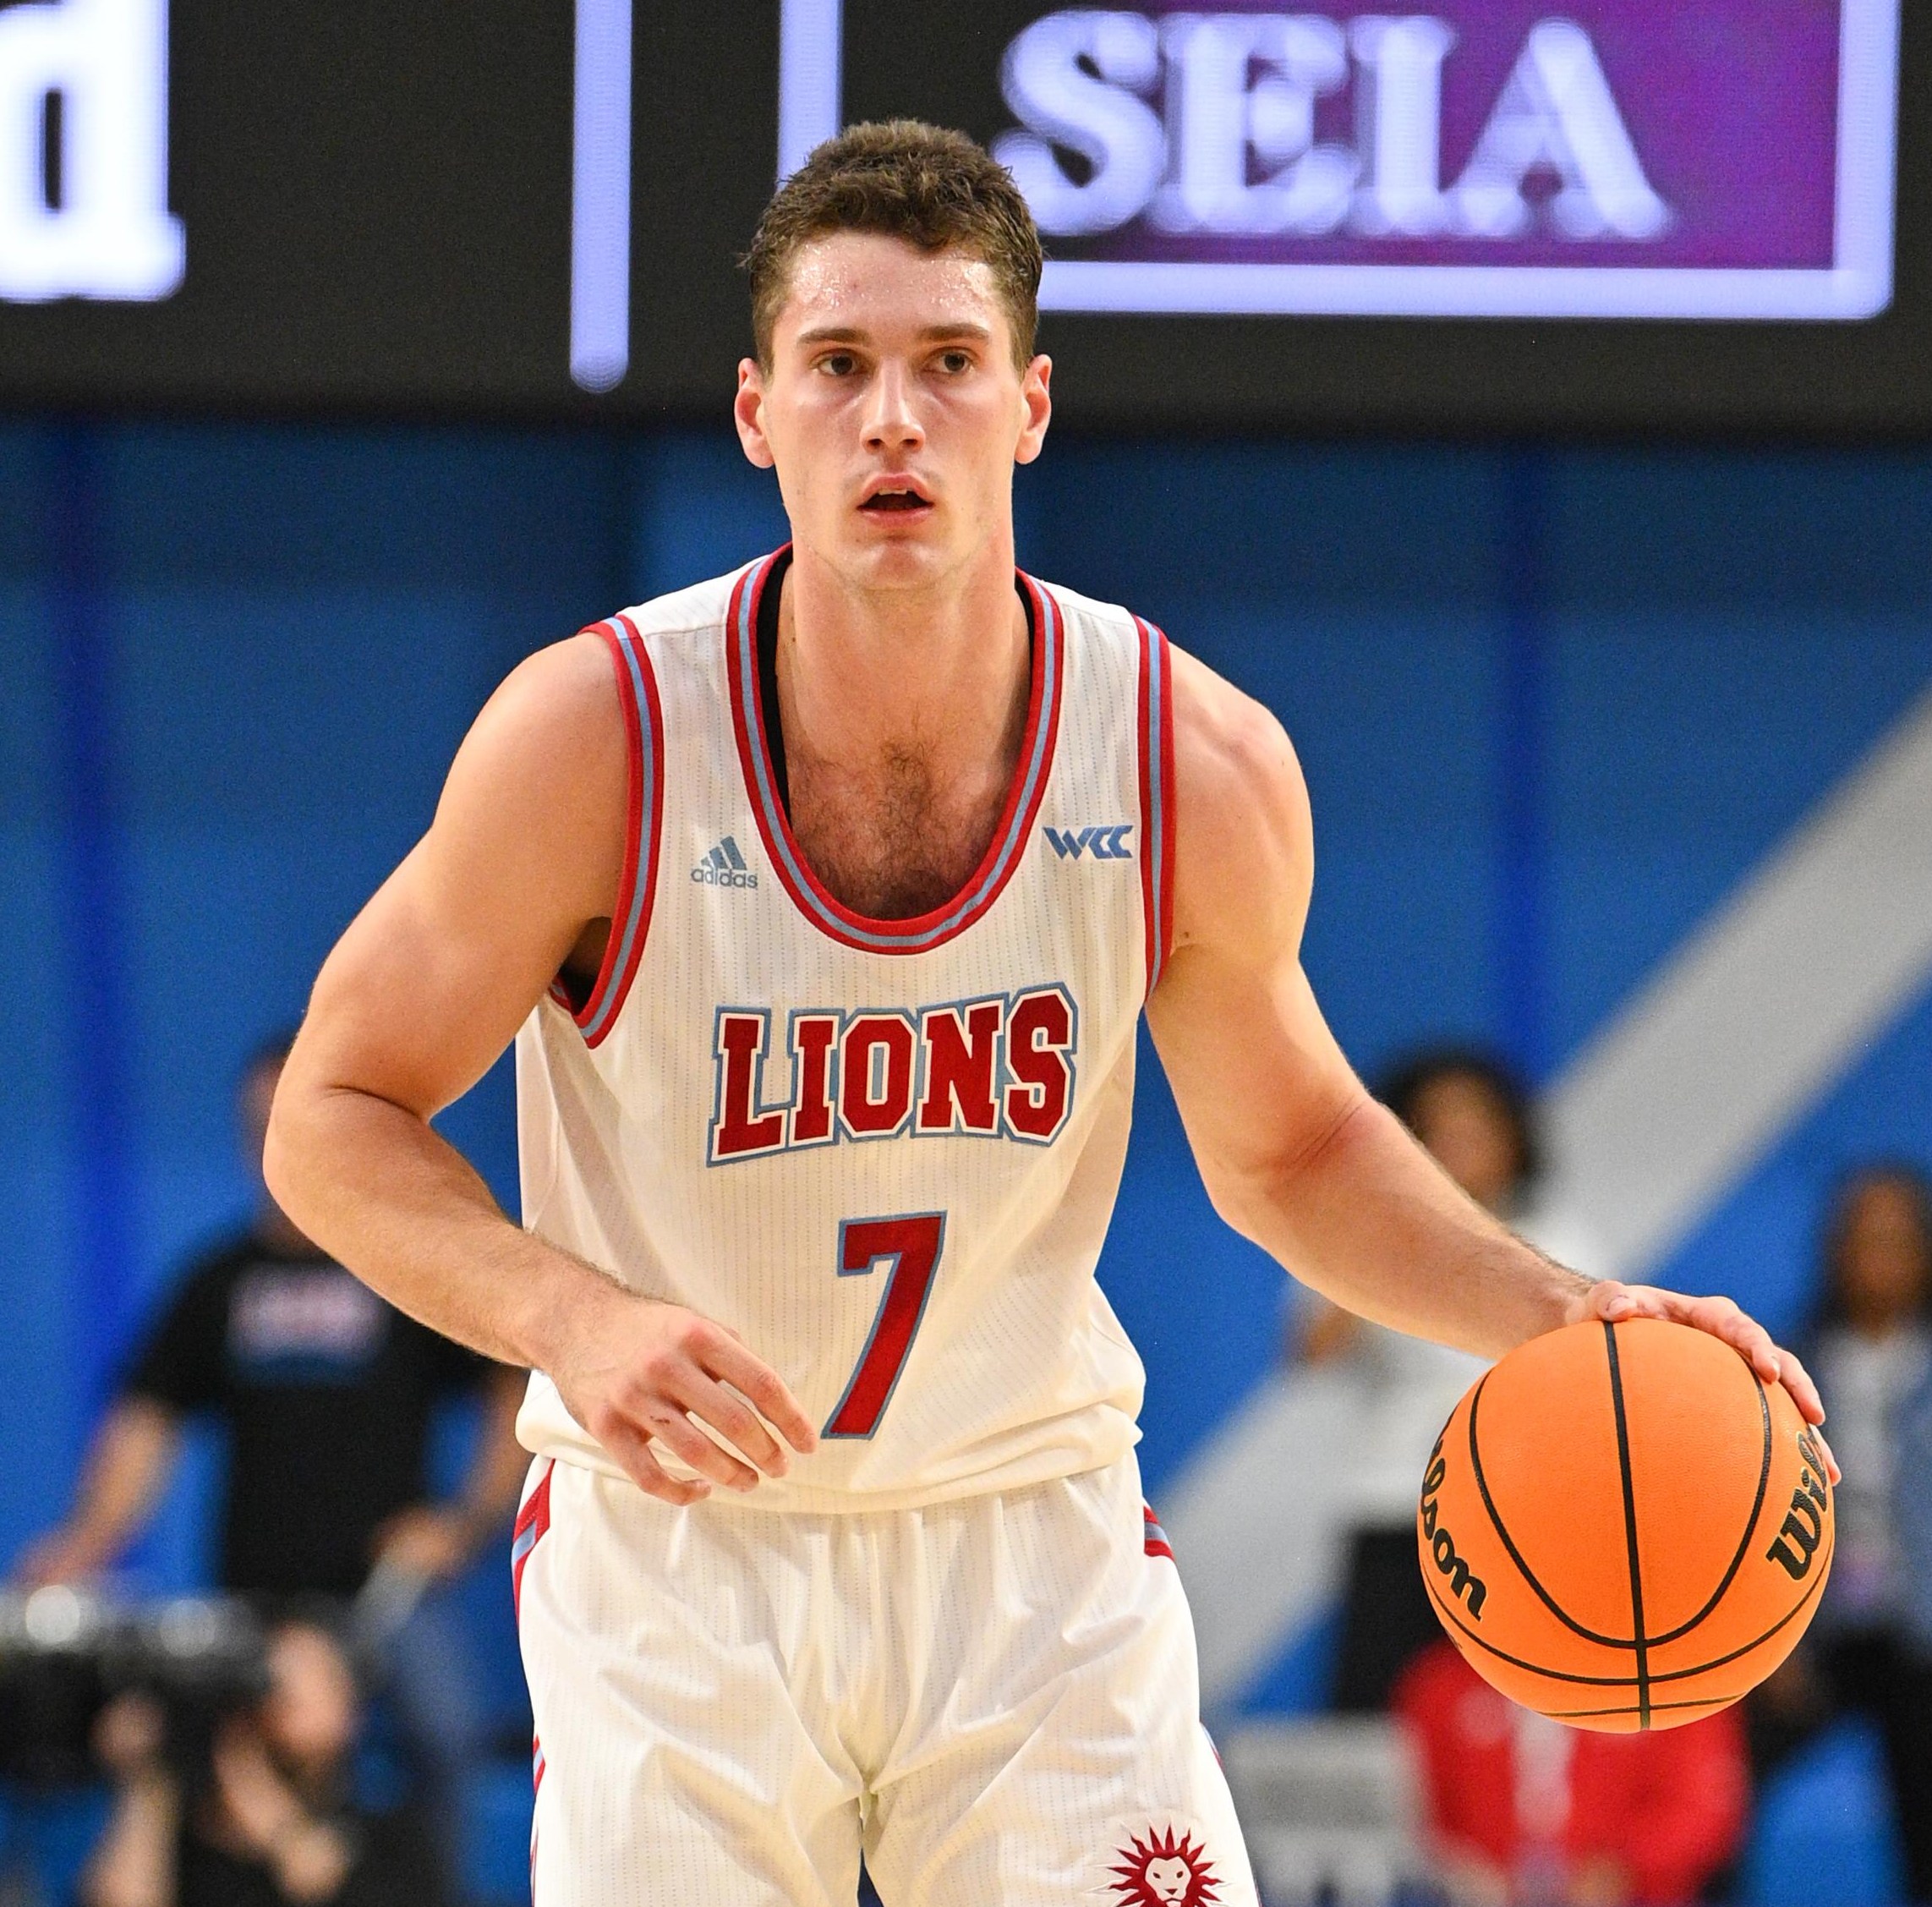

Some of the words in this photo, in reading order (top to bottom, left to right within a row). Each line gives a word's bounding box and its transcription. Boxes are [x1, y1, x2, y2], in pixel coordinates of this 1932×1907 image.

[992, 8, 1672, 238] SEIA
[691, 868, 758, 889] adidas
[1042, 825, 1134, 860] WCC
[706, 981, 1079, 1167] LIONS
[820, 1209, 948, 1440] 7
